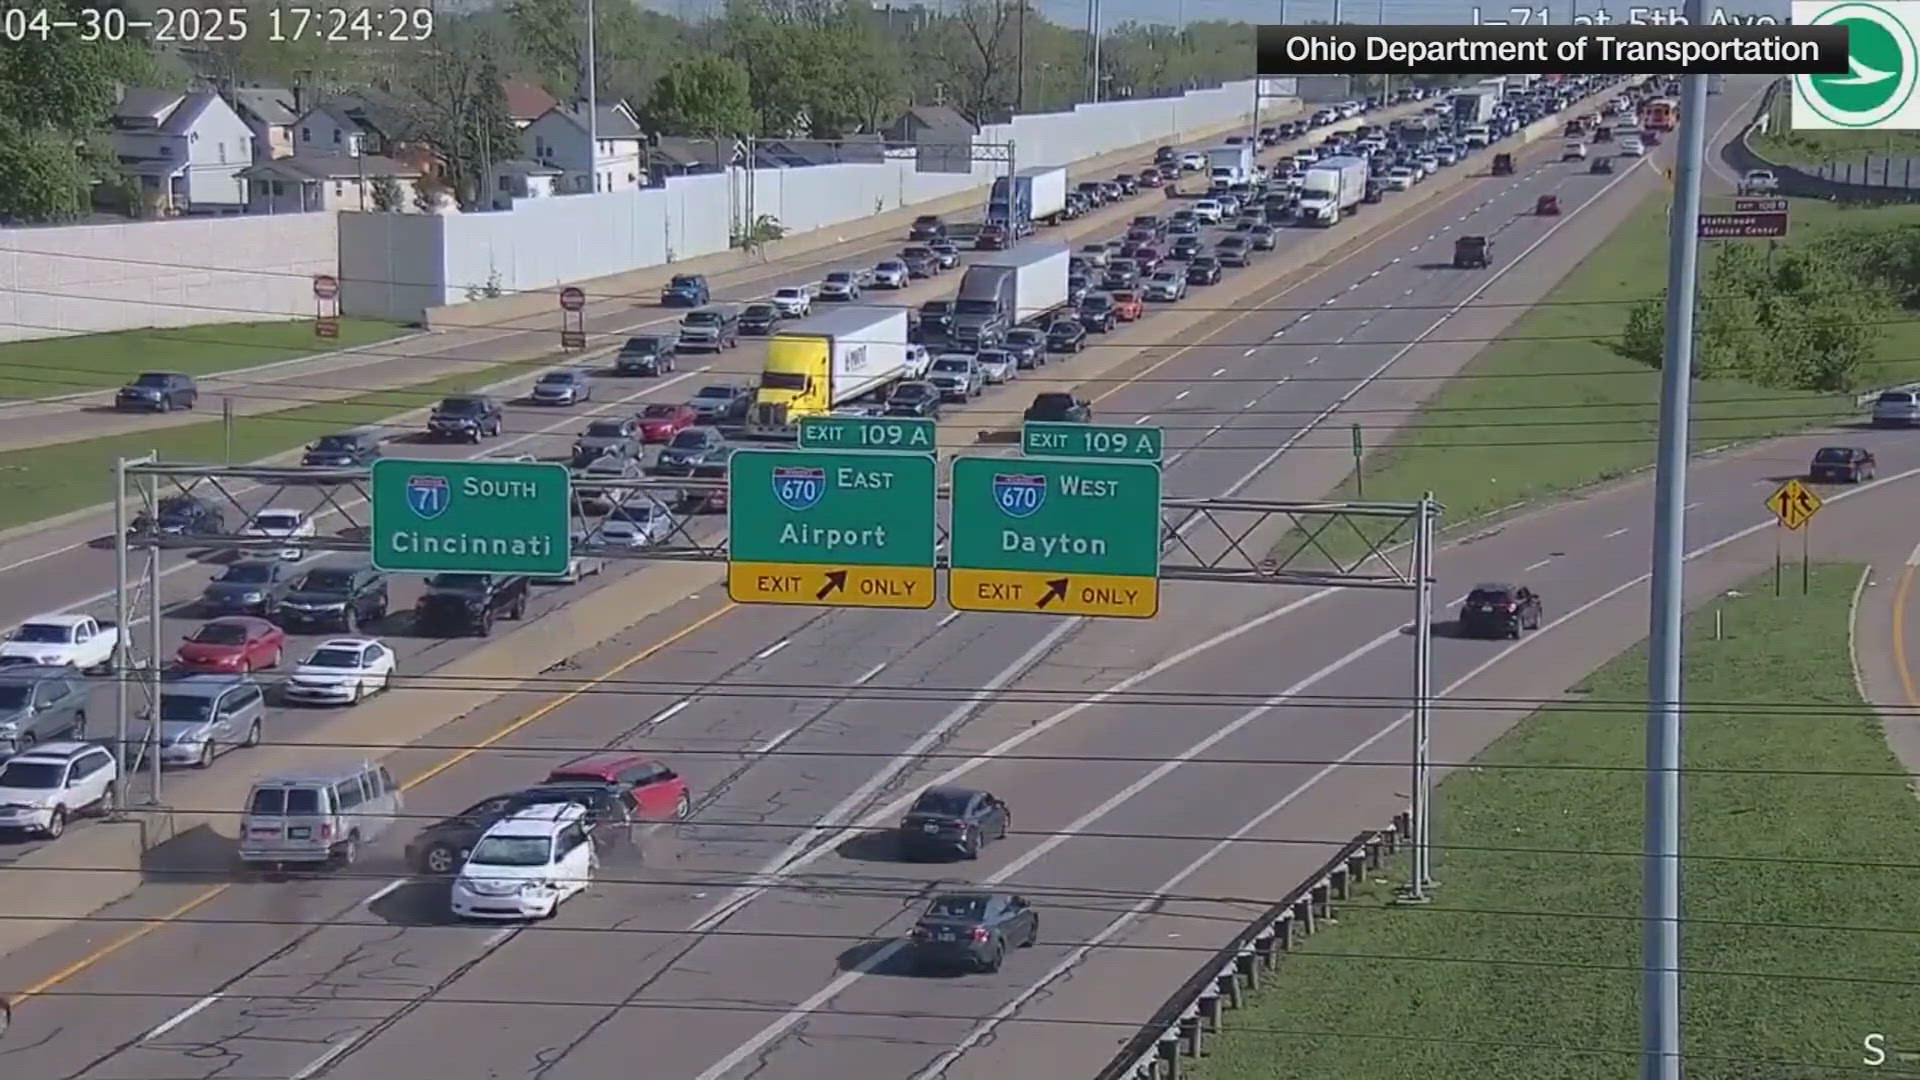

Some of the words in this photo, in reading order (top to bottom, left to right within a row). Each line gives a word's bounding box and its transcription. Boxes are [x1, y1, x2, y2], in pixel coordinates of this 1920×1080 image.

[806, 426, 845, 441] EXIT
[860, 425, 902, 444] 109
[910, 427, 928, 445] A
[1030, 433, 1069, 448] EXIT
[1084, 432, 1127, 453] 109
[1136, 434, 1153, 453] A
[414, 487, 440, 511] 71
[463, 476, 537, 498] SOUTH
[782, 480, 816, 501] 670
[837, 468, 894, 488] EAST
[1002, 487, 1037, 508] 670
[1060, 475, 1119, 497] WEST
[392, 532, 551, 556] Cincinnati
[780, 523, 886, 549] Airport
[1002, 530, 1106, 558] Dayton
[758, 576, 802, 593] EXIT
[860, 579, 916, 596] ONLY
[978, 583, 1022, 600] EXIT
[1081, 587, 1138, 605] ONLY
